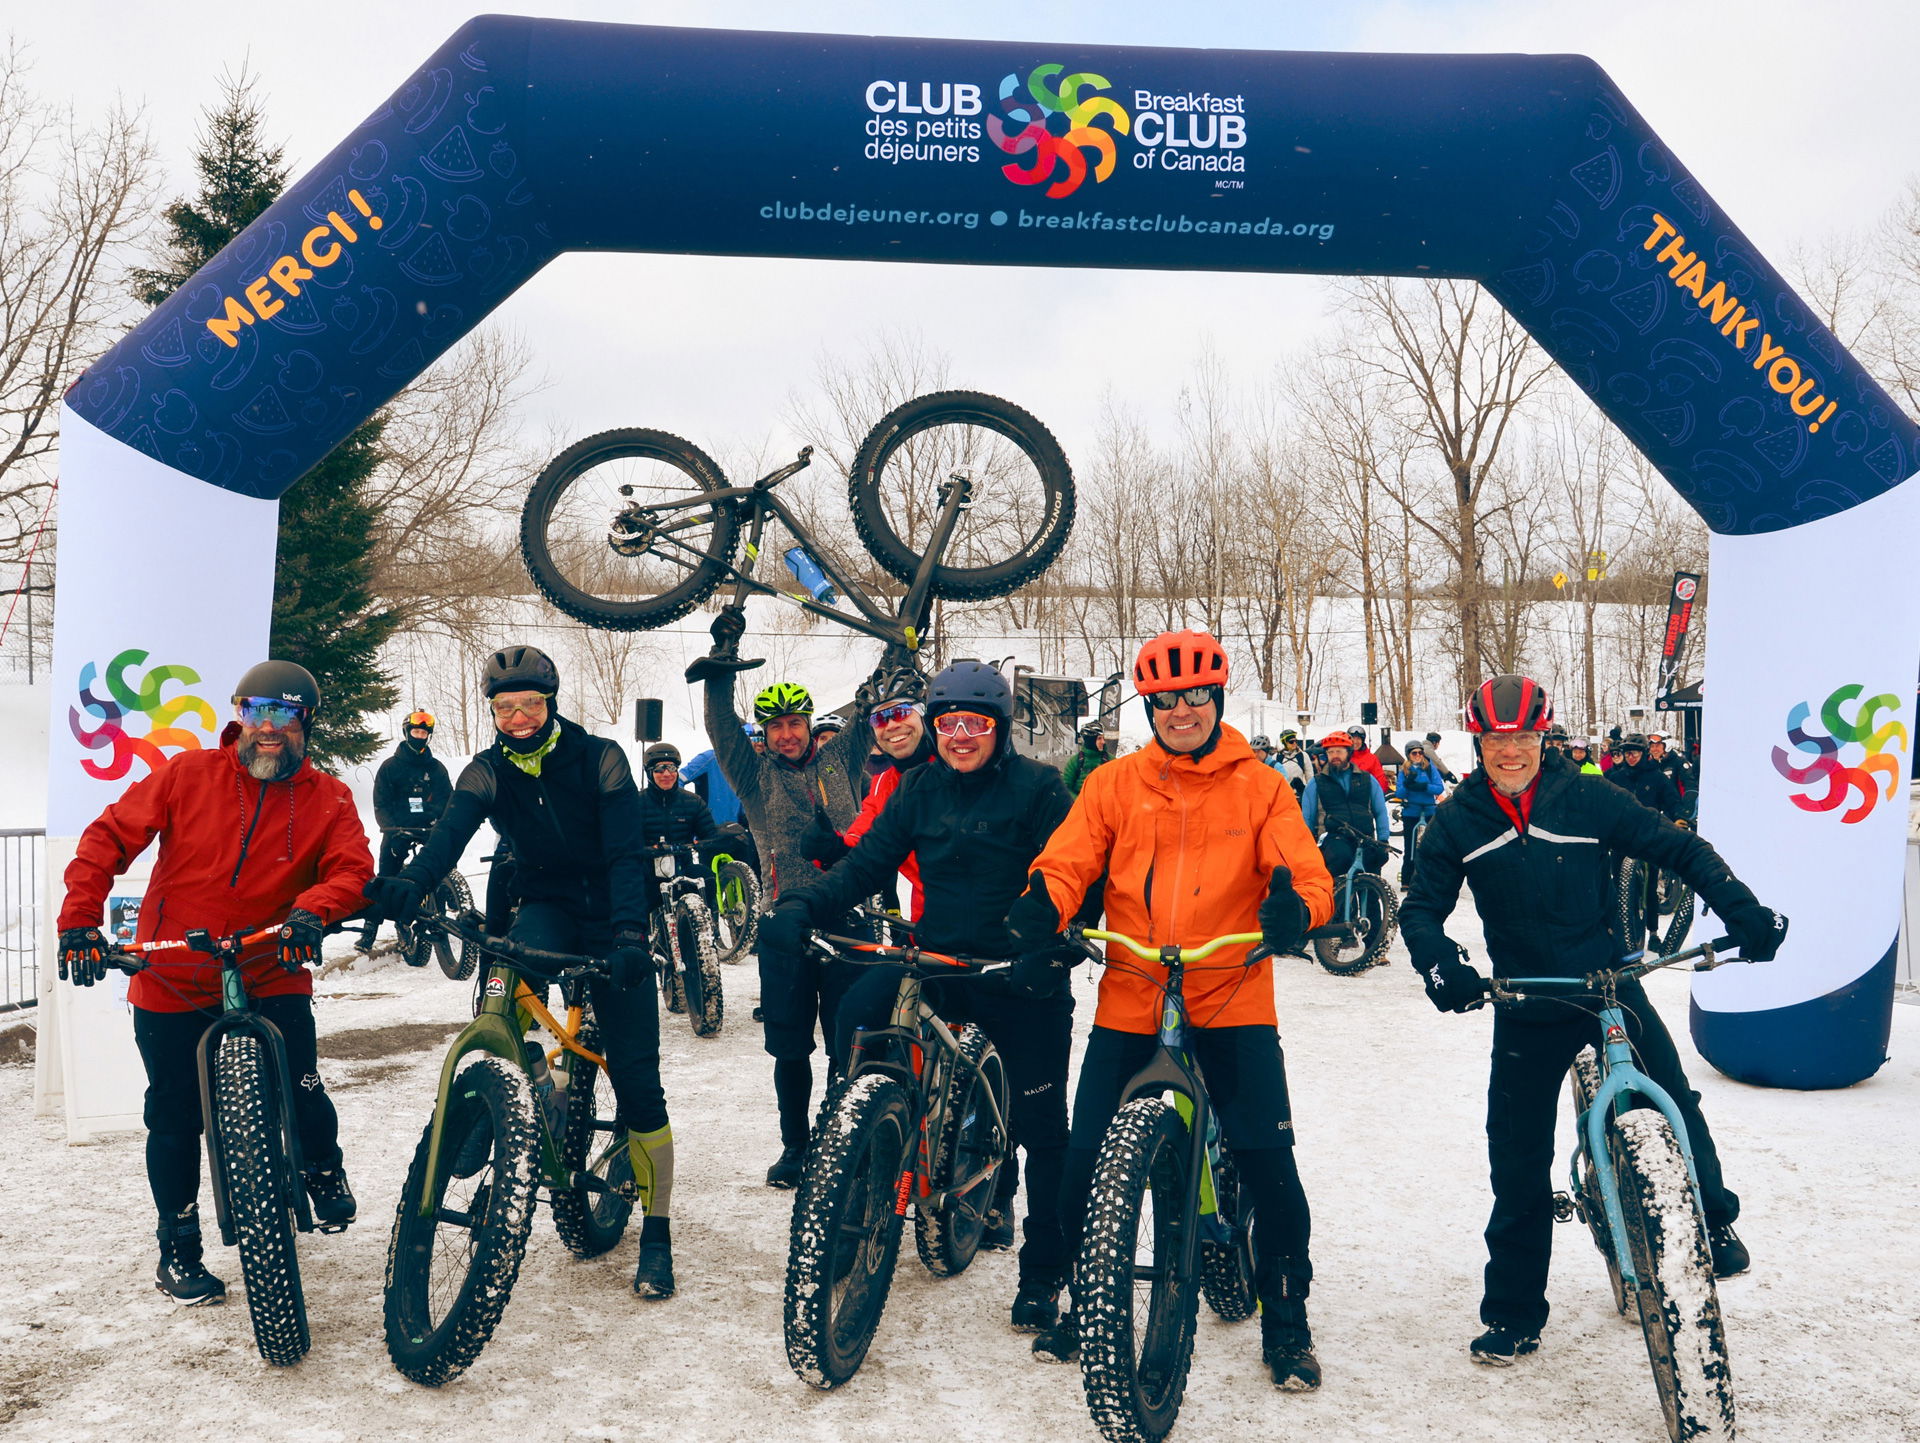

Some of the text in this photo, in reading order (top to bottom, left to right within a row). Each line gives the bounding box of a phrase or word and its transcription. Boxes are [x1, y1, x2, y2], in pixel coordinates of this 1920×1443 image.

[865, 80, 982, 116] CLUB
[1134, 90, 1246, 114] Breakfast
[865, 117, 982, 143] des petits
[1133, 111, 1247, 149] CLUB
[864, 135, 981, 165] déjeuners
[1133, 147, 1246, 173] of Canada
[1214, 180, 1245, 190] MC/TM
[759, 201, 1336, 240] clubdejeuner.org breakfastclubcanada.org
[206, 211, 358, 348] MERCI
[1643, 213, 1838, 434] THANK YOU!
[1025, 490, 1063, 558] BONTRAGER
[1663, 613, 1681, 656] ESPRESSO
[1023, 1082, 1053, 1096] MALOJA
[895, 1170, 914, 1217] ROCKSHOX
